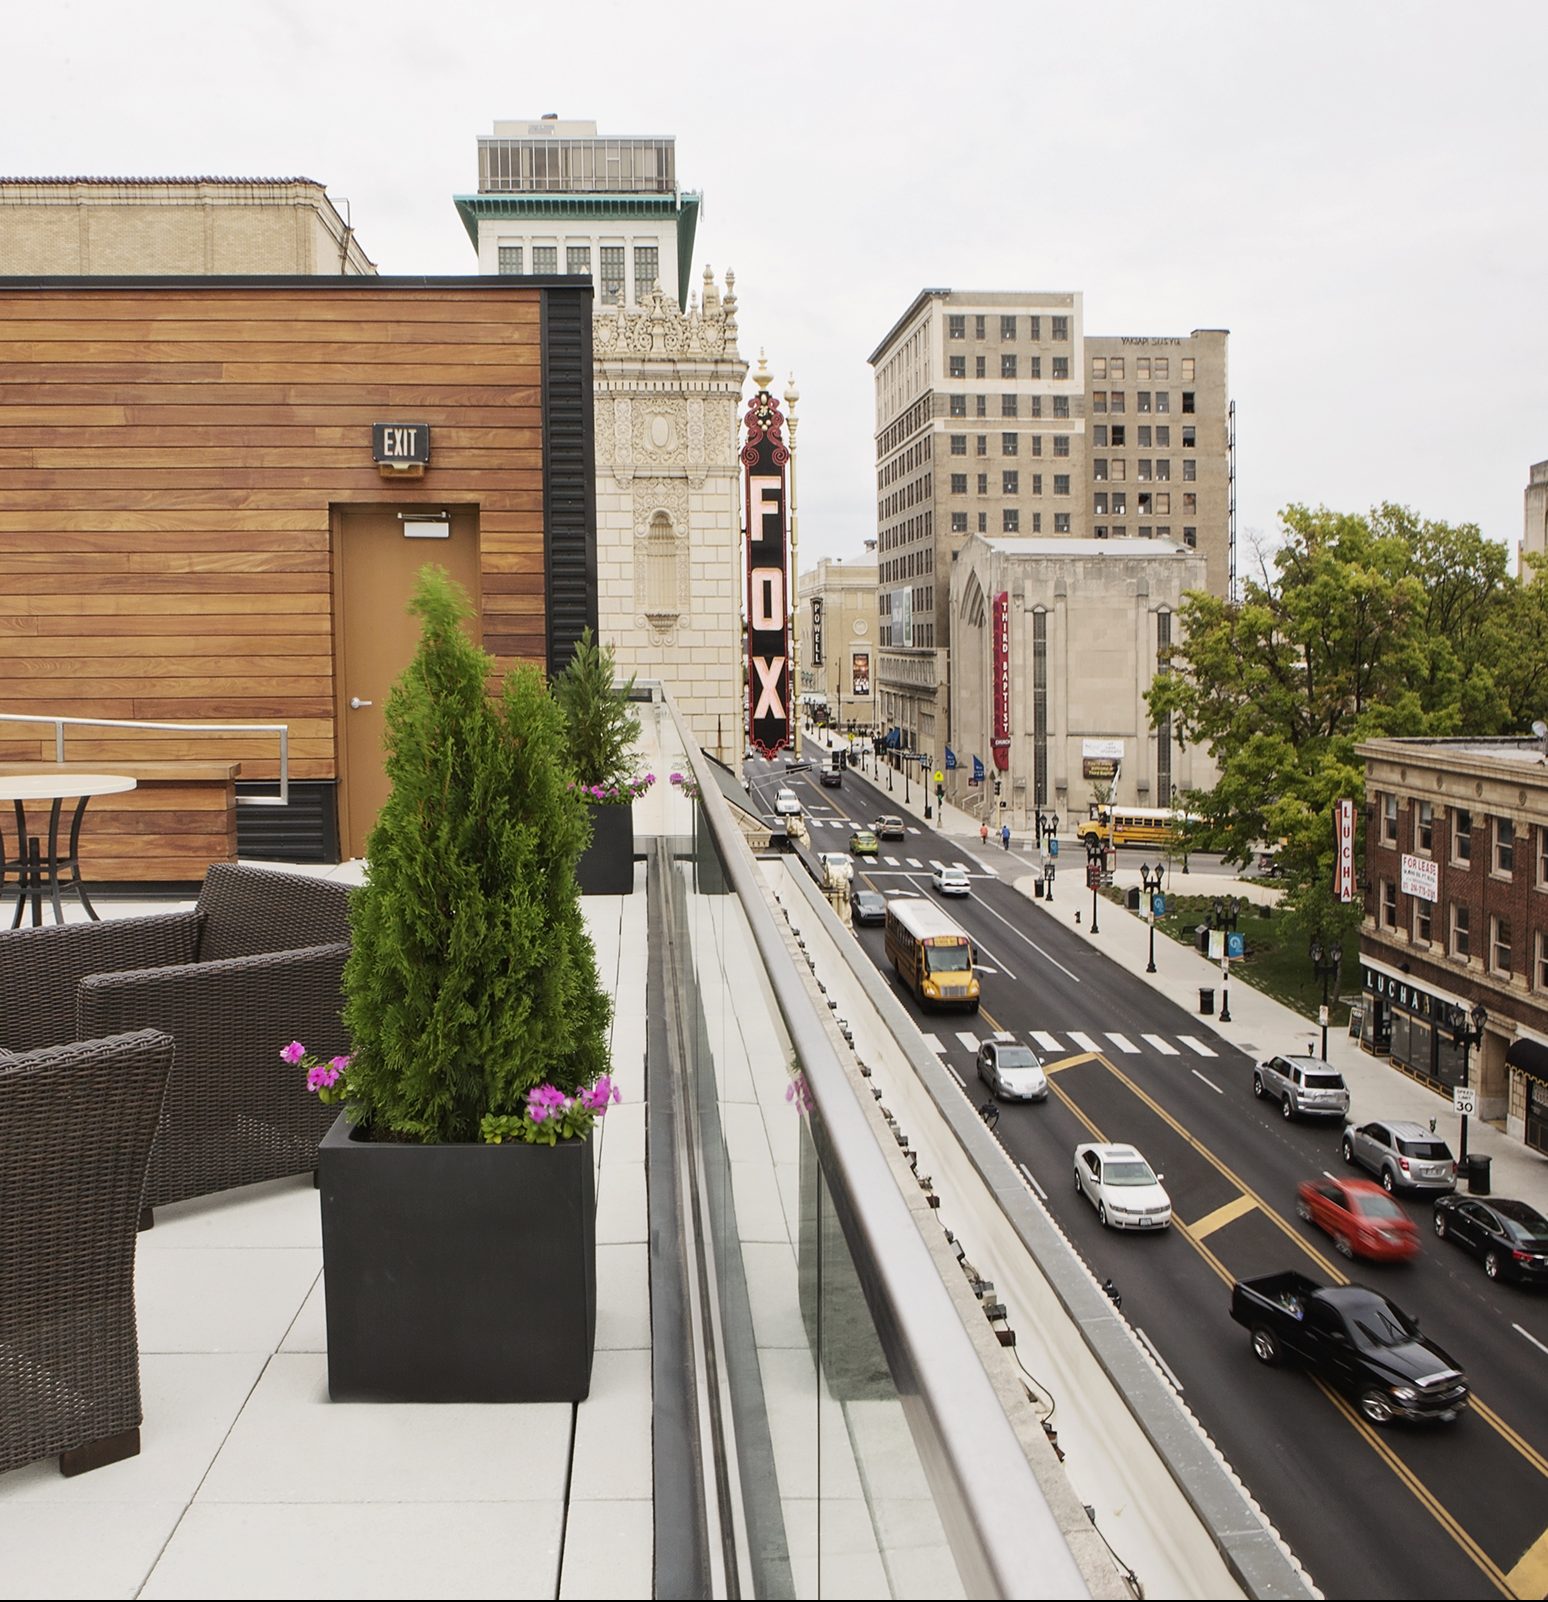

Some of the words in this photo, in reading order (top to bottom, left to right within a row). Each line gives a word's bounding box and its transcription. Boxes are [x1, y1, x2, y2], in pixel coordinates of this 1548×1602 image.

[383, 428, 417, 457] EXIT
[749, 474, 788, 720] FOX
[1342, 805, 1351, 898] LUCHA
[1403, 855, 1418, 870] FOR
[1418, 859, 1436, 877] LEASE
[1456, 1100, 1473, 1113] 30
